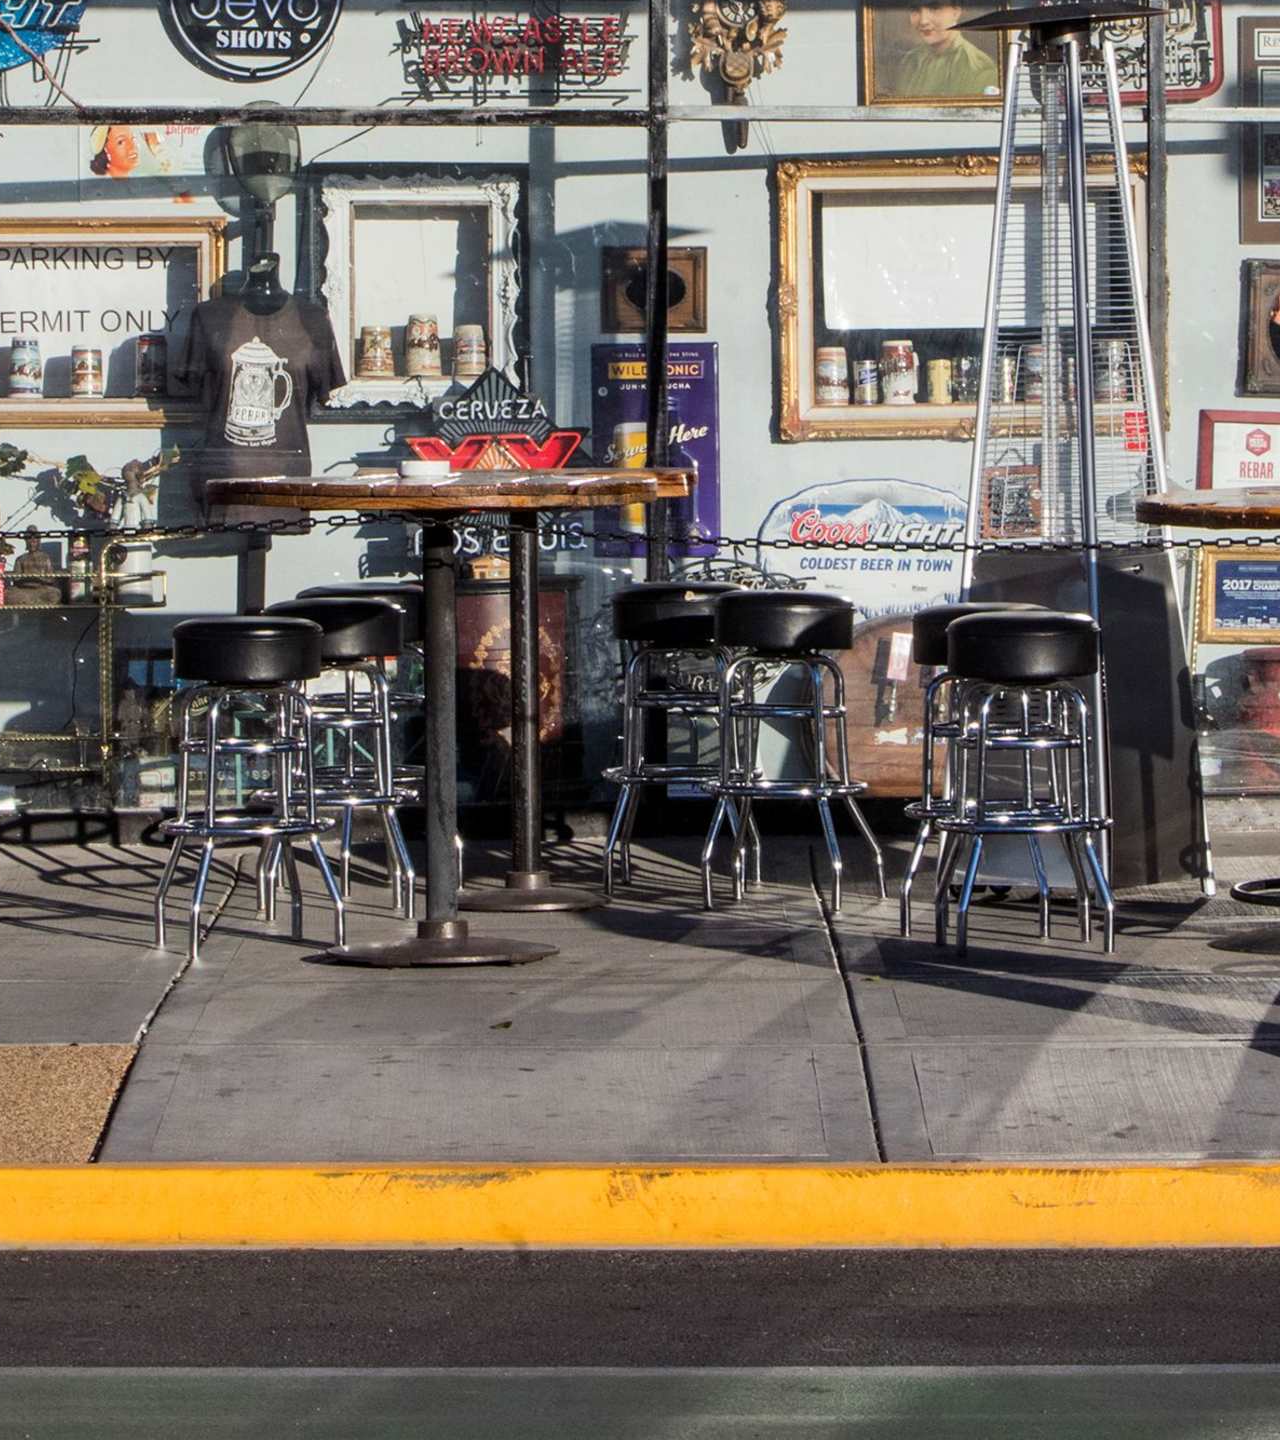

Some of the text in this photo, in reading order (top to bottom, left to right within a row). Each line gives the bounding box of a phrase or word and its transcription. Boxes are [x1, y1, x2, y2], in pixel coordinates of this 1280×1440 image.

[216, 29, 292, 49] SHOTS
[423, 15, 623, 45] NEWCASTLE
[423, 47, 622, 77] BROWN ALE
[136, 247, 175, 270] BY
[100, 309, 180, 334] ONLY
[439, 399, 549, 421] CERVEZA
[669, 422, 710, 446] Here
[1240, 461, 1274, 479] REBAR
[789, 510, 962, 545] Coors LIGHT
[799, 557, 953, 572] COLDEST BEER IN TOWN
[1222, 579, 1252, 591] 2017
